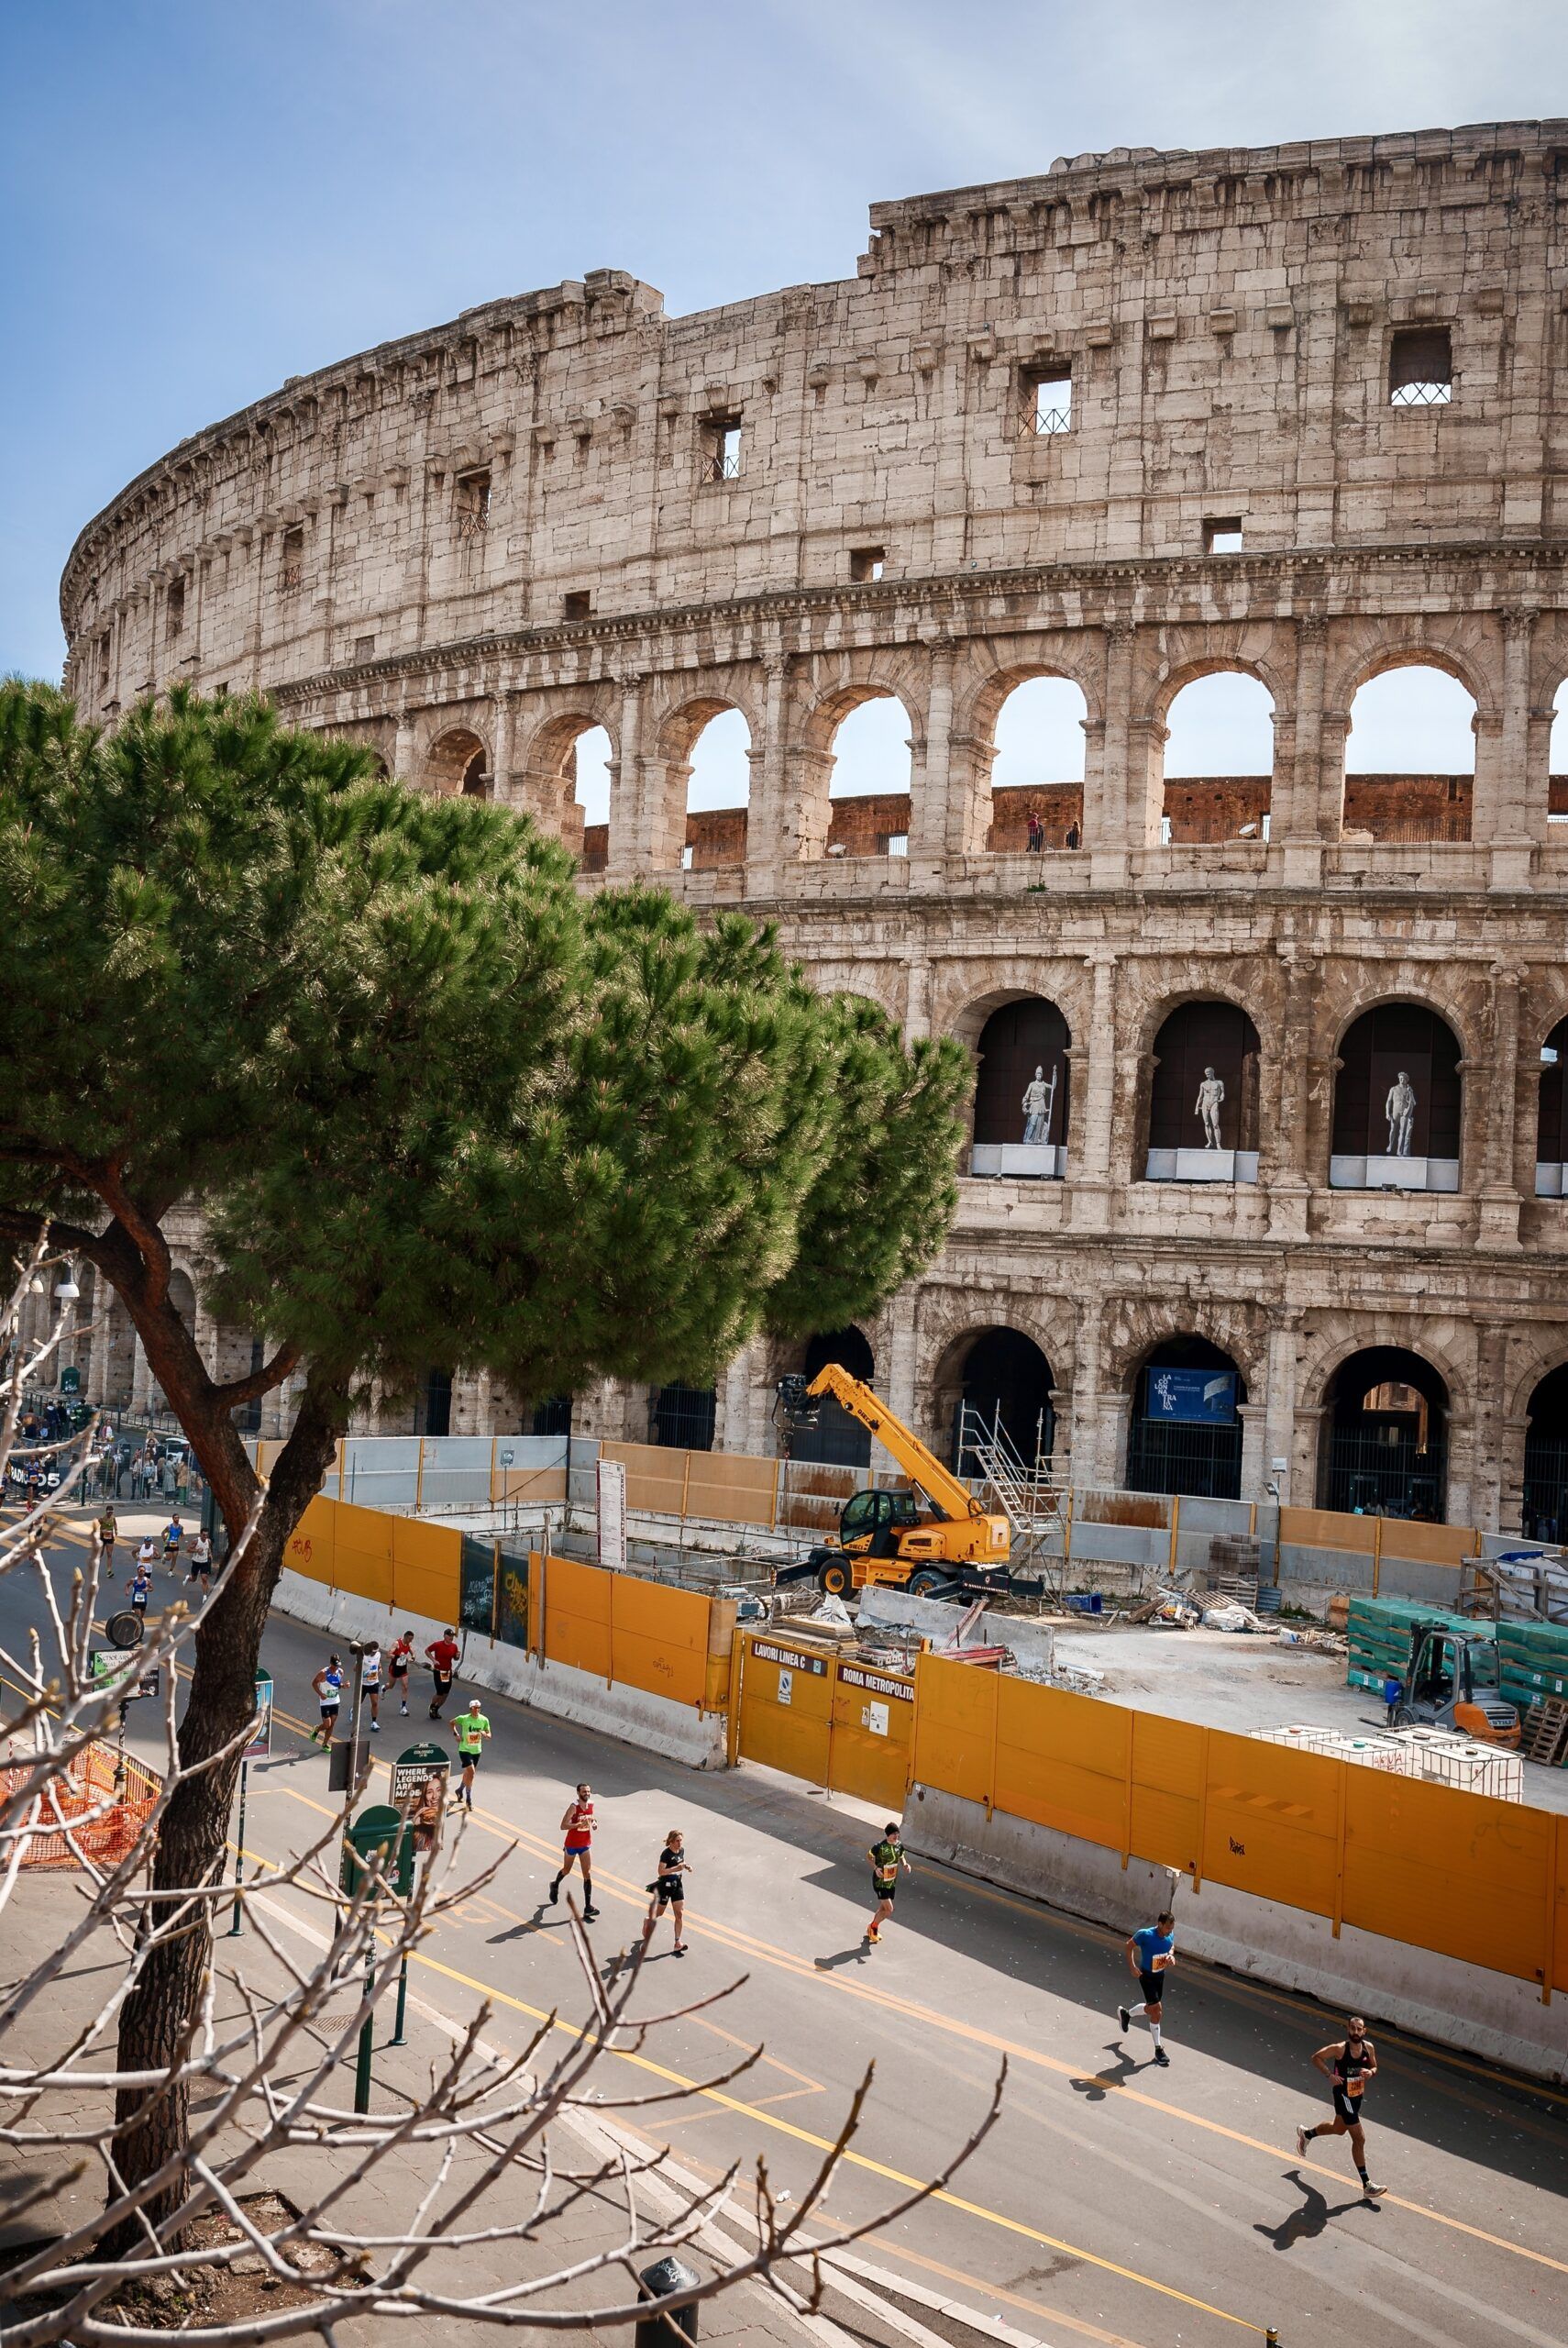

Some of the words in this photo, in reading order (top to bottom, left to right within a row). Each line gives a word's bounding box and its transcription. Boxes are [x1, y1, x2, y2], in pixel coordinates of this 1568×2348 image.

[755, 1643, 778, 1661] LAVORI
[778, 1649, 800, 1667] LINEA
[800, 1656, 806, 1669] C
[843, 1667, 864, 1686] ROMA
[866, 1674, 914, 1701] METROPOLITA
[396, 1775, 434, 1784] LEGENDS
[397, 1767, 427, 1777] WHERE
